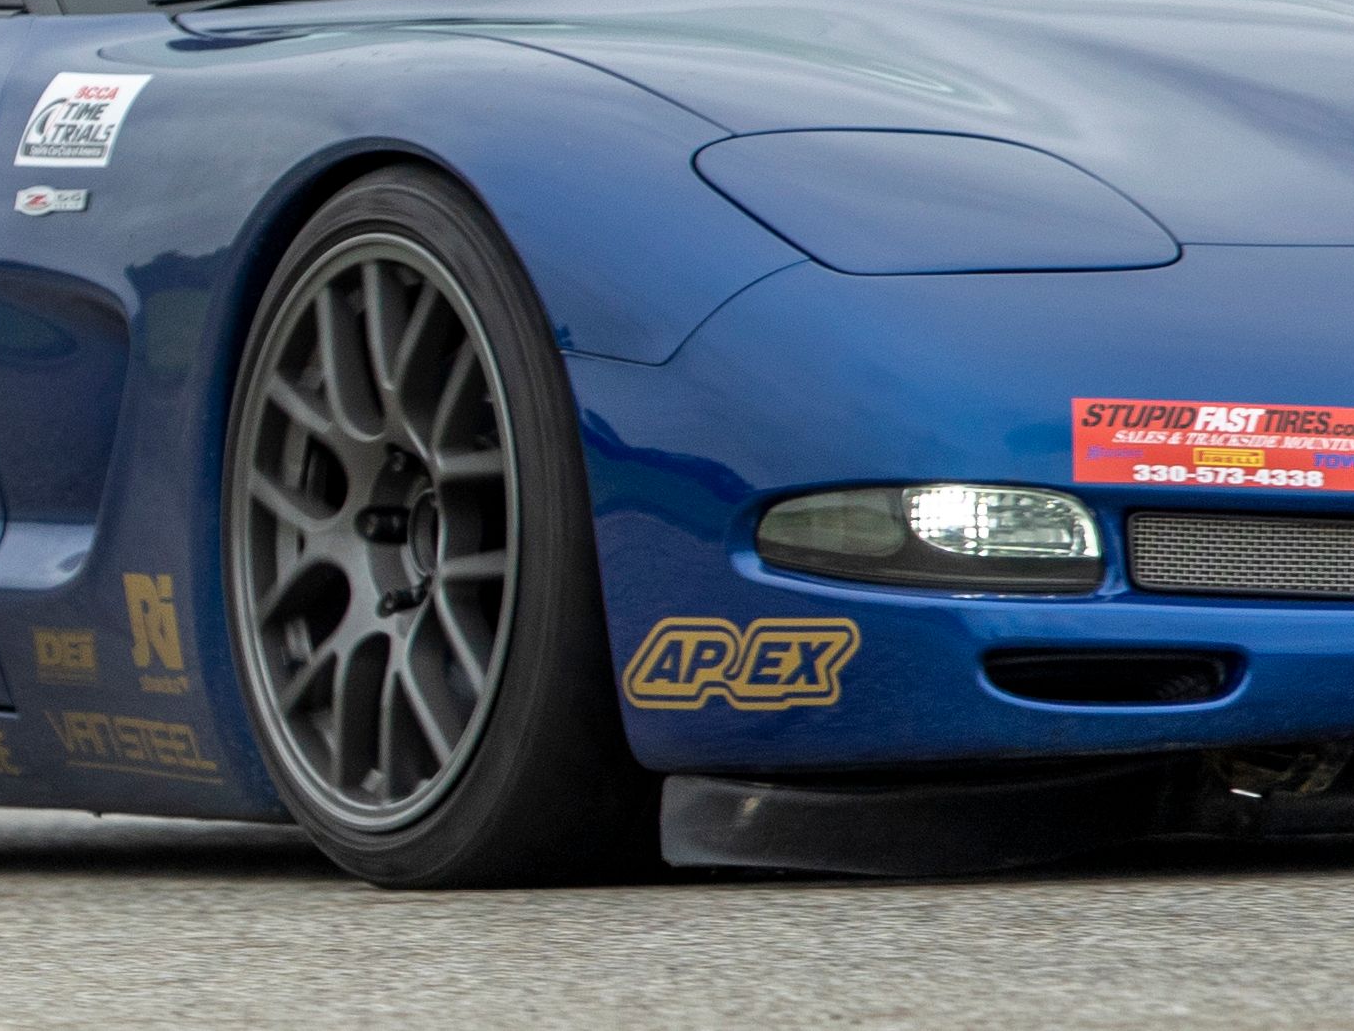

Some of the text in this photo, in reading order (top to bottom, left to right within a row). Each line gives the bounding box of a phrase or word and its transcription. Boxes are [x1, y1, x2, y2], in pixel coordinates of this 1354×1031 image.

[75, 86, 119, 101] SCCA
[63, 103, 109, 120] TIME
[49, 123, 116, 143] TRIALS
[1111, 429, 1168, 446] SALES
[1166, 431, 1184, 446] &
[1184, 432, 1283, 451] TRACKSIDE
[1132, 465, 1324, 488] 330-573-4338
